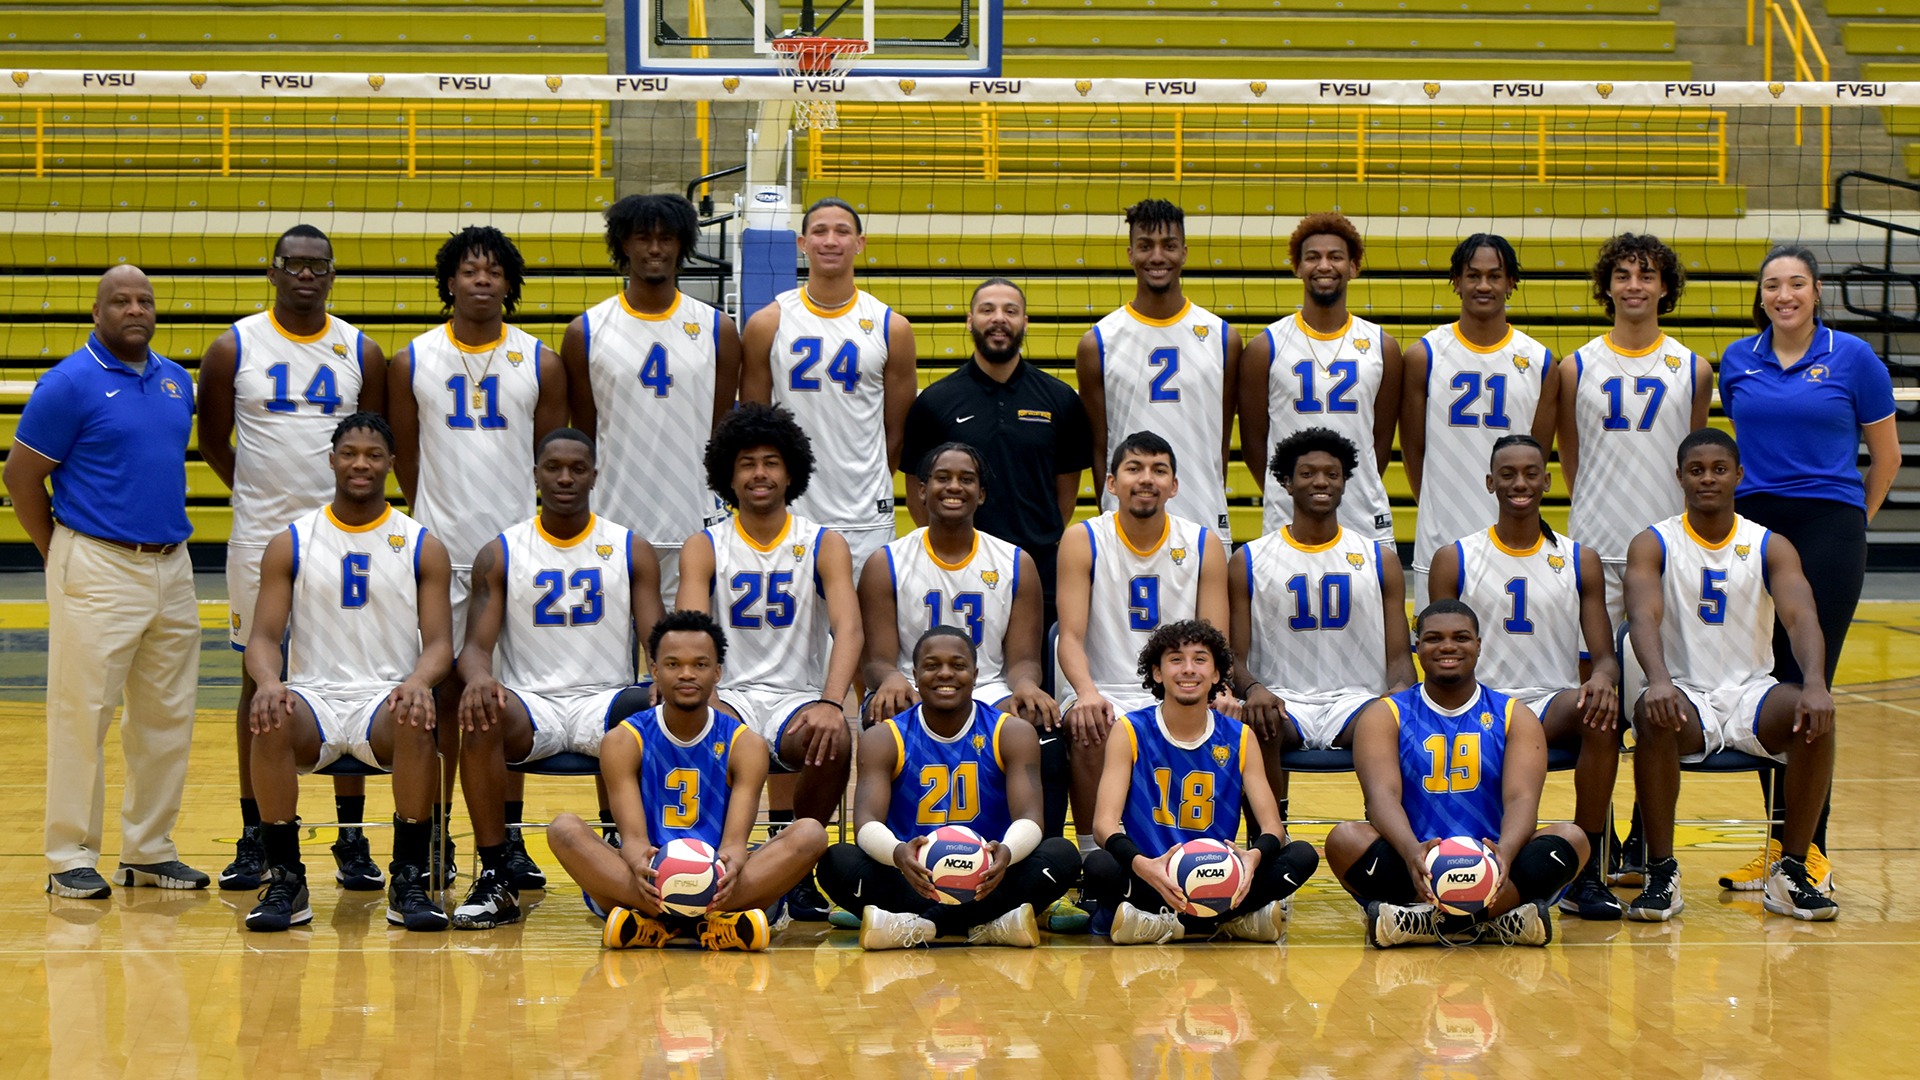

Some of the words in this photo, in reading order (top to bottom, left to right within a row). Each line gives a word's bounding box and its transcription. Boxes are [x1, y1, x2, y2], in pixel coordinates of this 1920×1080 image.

[82, 73, 135, 87] FVSU
[261, 74, 314, 89] FVSU
[438, 76, 491, 90] FVSU
[616, 77, 668, 92] FVSU
[793, 79, 845, 93] FVSU
[969, 80, 1022, 94] FVSU
[1145, 81, 1197, 95] FVSU
[1319, 82, 1371, 97] FVSU
[1492, 83, 1544, 98] FVSU
[1665, 83, 1716, 98] FVSU
[1836, 83, 1887, 97] FVSU
[265, 362, 342, 414] 14
[638, 342, 674, 398] 4
[789, 337, 861, 393] 24
[1149, 347, 1180, 402] 2
[1293, 361, 1360, 414] 12
[445, 373, 508, 431] 11
[1449, 371, 1511, 429] 21
[1601, 376, 1667, 431] 17
[341, 552, 371, 608] 6
[533, 568, 604, 626] 23
[730, 570, 796, 629] 25
[1129, 575, 1160, 632] 9
[1285, 573, 1352, 631] 10
[1504, 577, 1535, 634] 1
[1698, 568, 1728, 624] 5
[923, 589, 984, 649] 13
[1422, 732, 1481, 793] 19
[663, 767, 700, 829] 3
[916, 761, 980, 826] 20
[1152, 767, 1215, 832] 18
[944, 858, 974, 870] NCAA
[945, 844, 973, 852] molten
[1195, 853, 1222, 862] molten
[1196, 868, 1225, 878] NCAA
[1447, 857, 1475, 865] molten
[1447, 873, 1477, 883] NCAA
